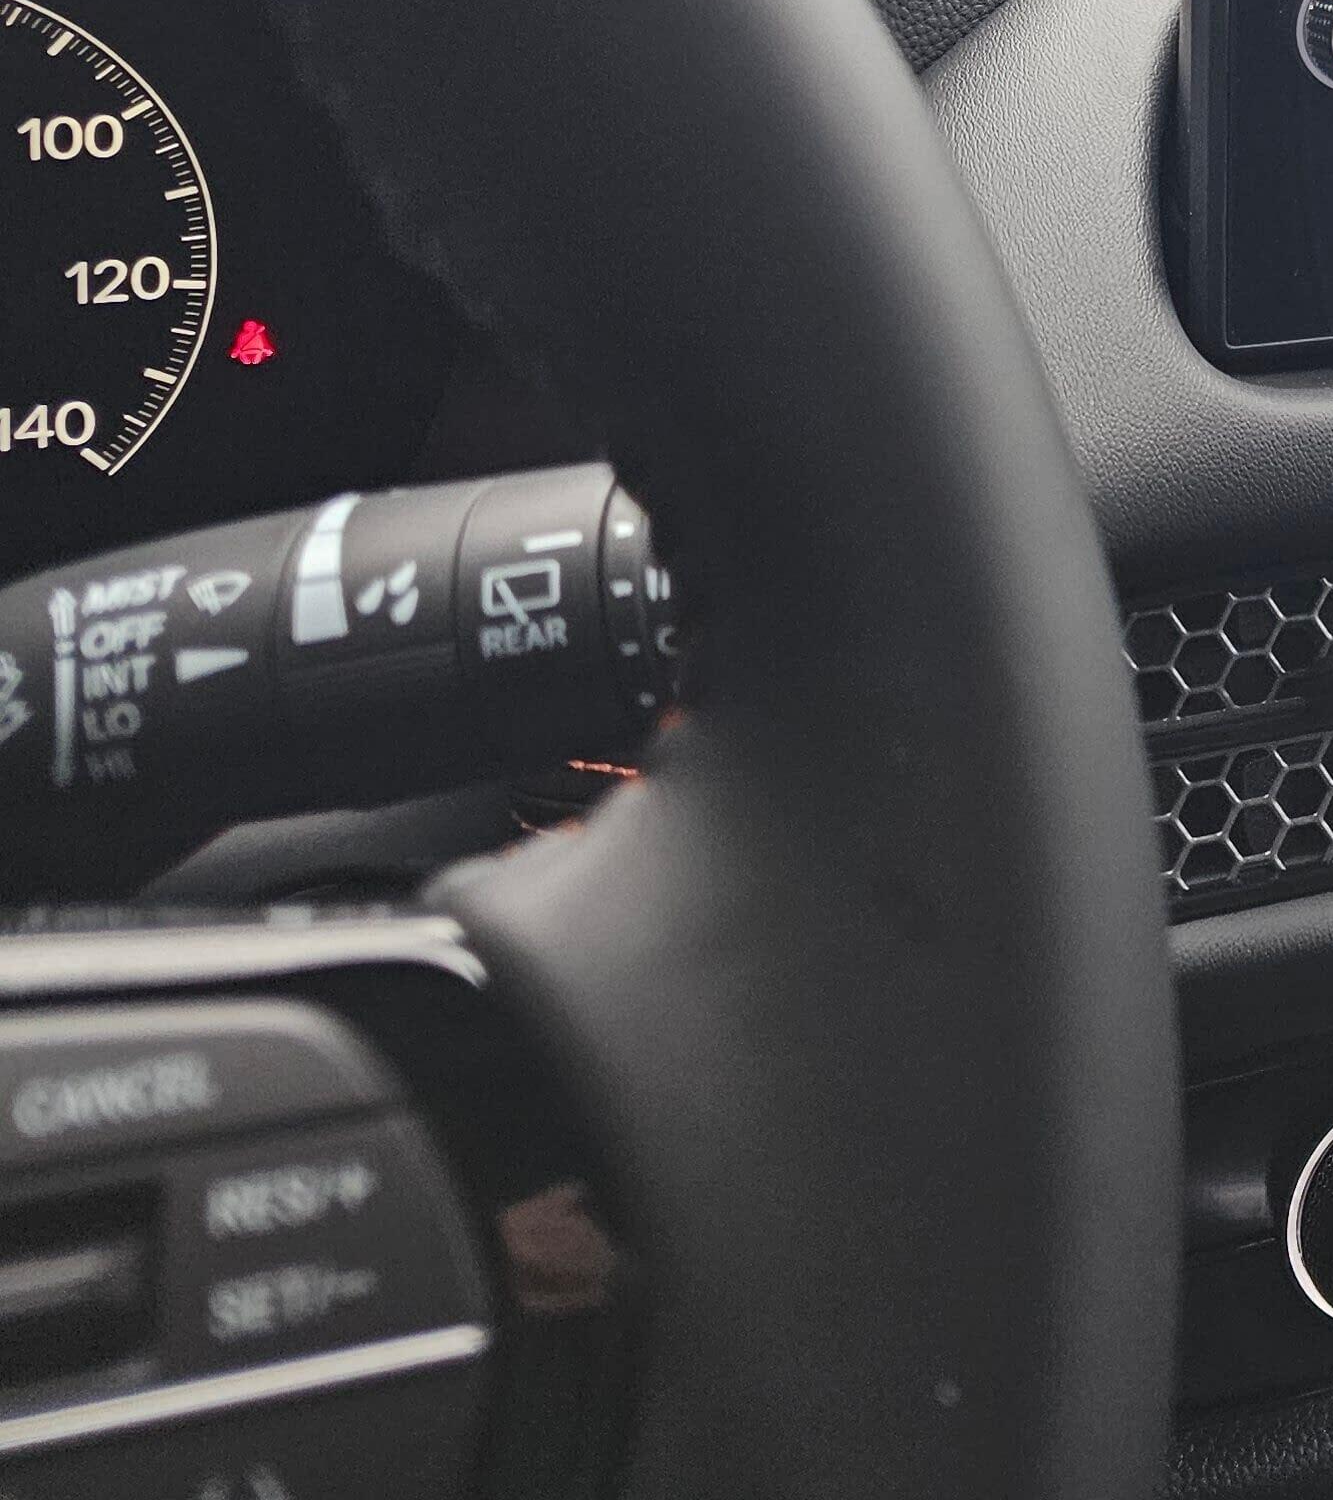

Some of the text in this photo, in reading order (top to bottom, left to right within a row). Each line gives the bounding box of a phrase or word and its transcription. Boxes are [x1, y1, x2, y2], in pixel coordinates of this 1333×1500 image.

[17, 115, 124, 161] 100
[64, 256, 170, 305] 120
[0, 400, 96, 452] 140
[79, 611, 167, 660] OFF
[480, 615, 568, 662] REAR
